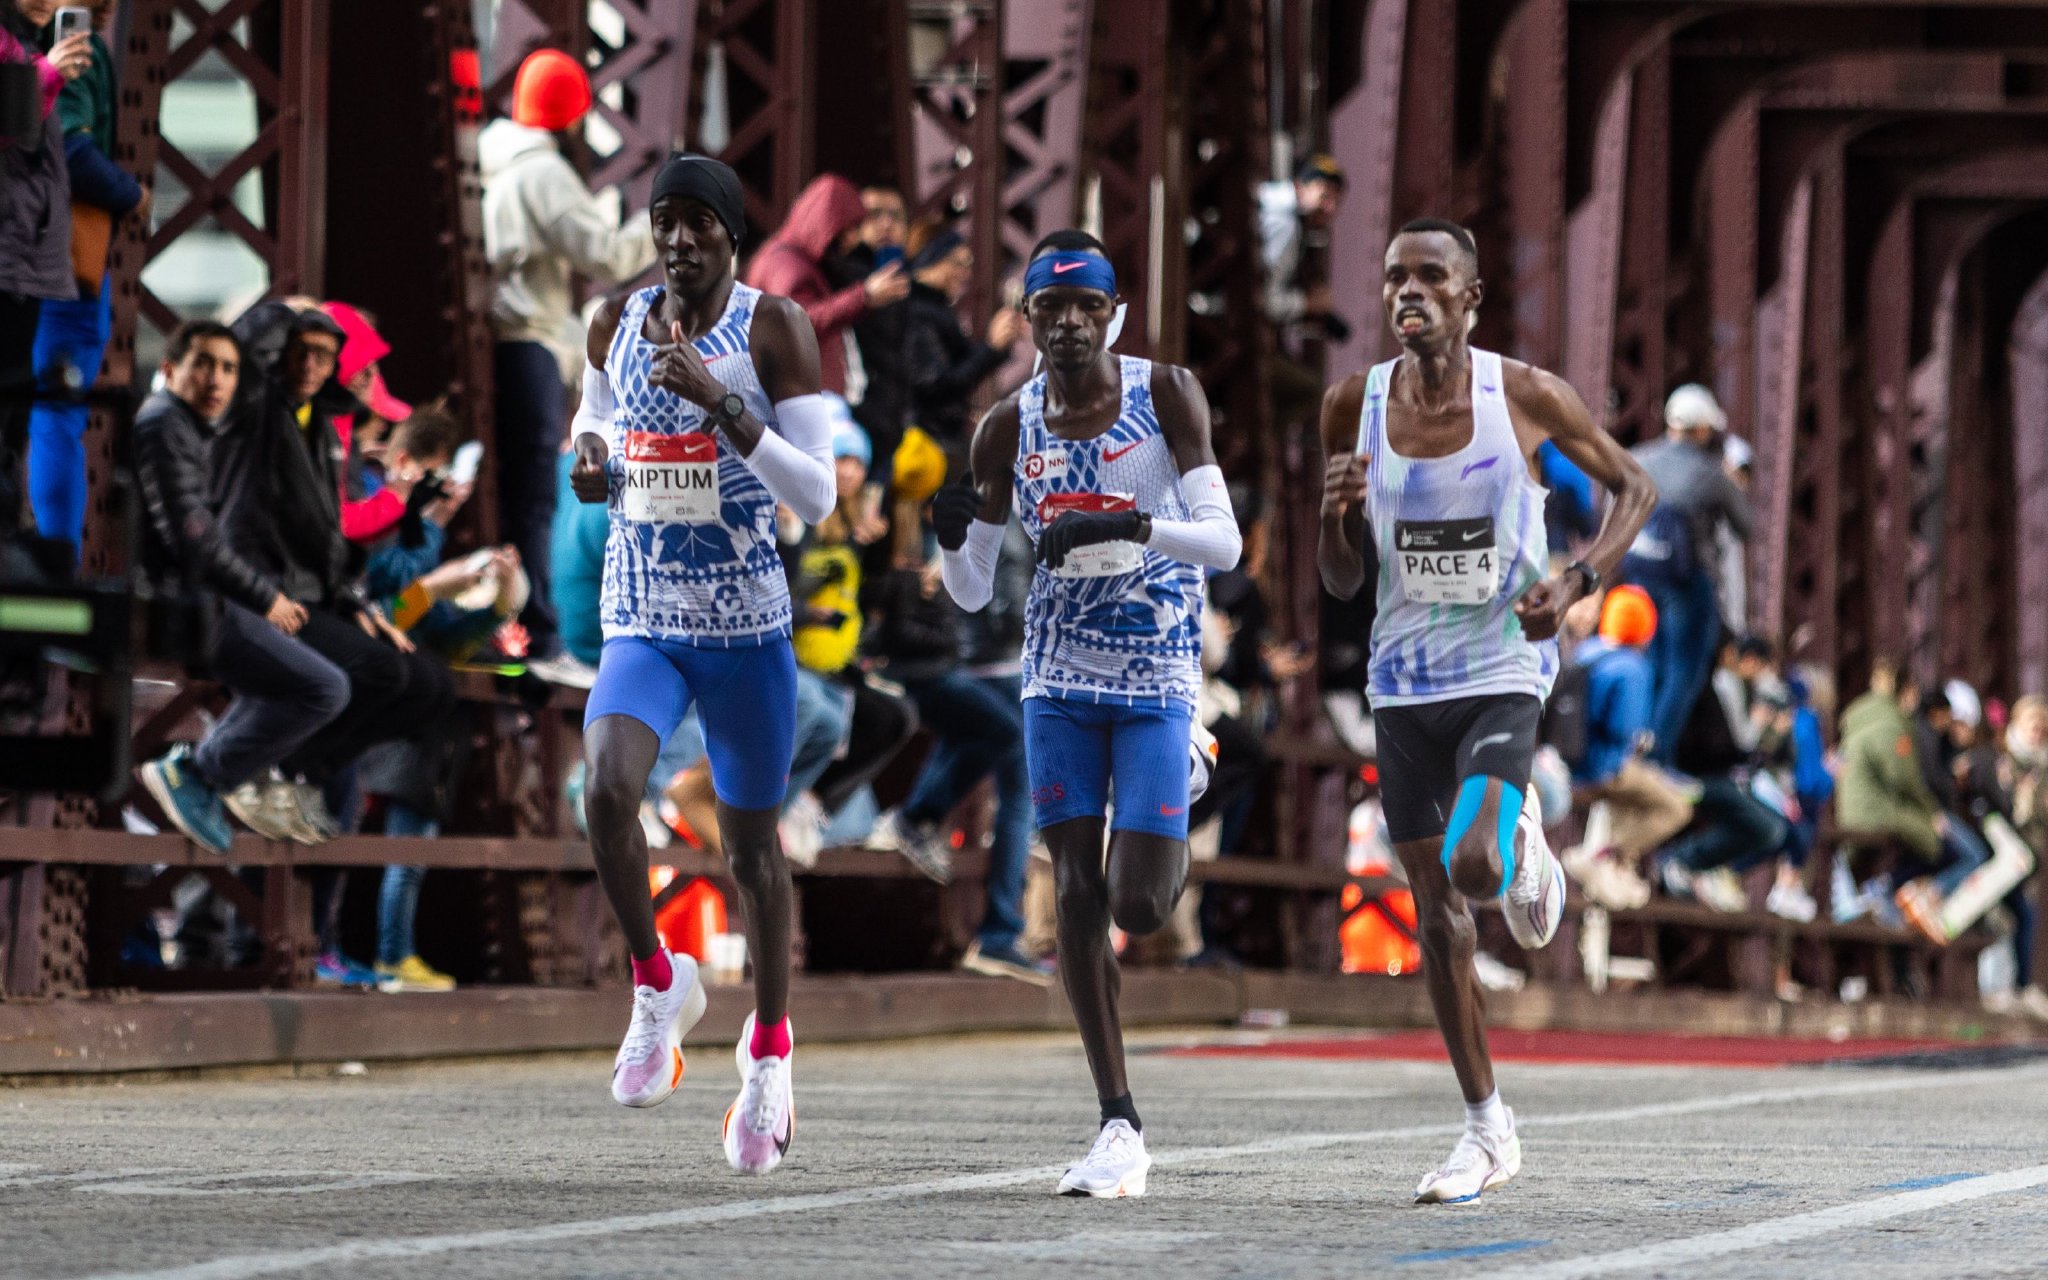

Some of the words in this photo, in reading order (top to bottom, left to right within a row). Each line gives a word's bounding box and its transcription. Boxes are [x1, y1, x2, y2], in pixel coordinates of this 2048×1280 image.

[1048, 457, 1065, 468] NN
[628, 468, 712, 490] KIPTUM
[1405, 554, 1468, 576] PACE
[1477, 552, 1492, 573] 4
